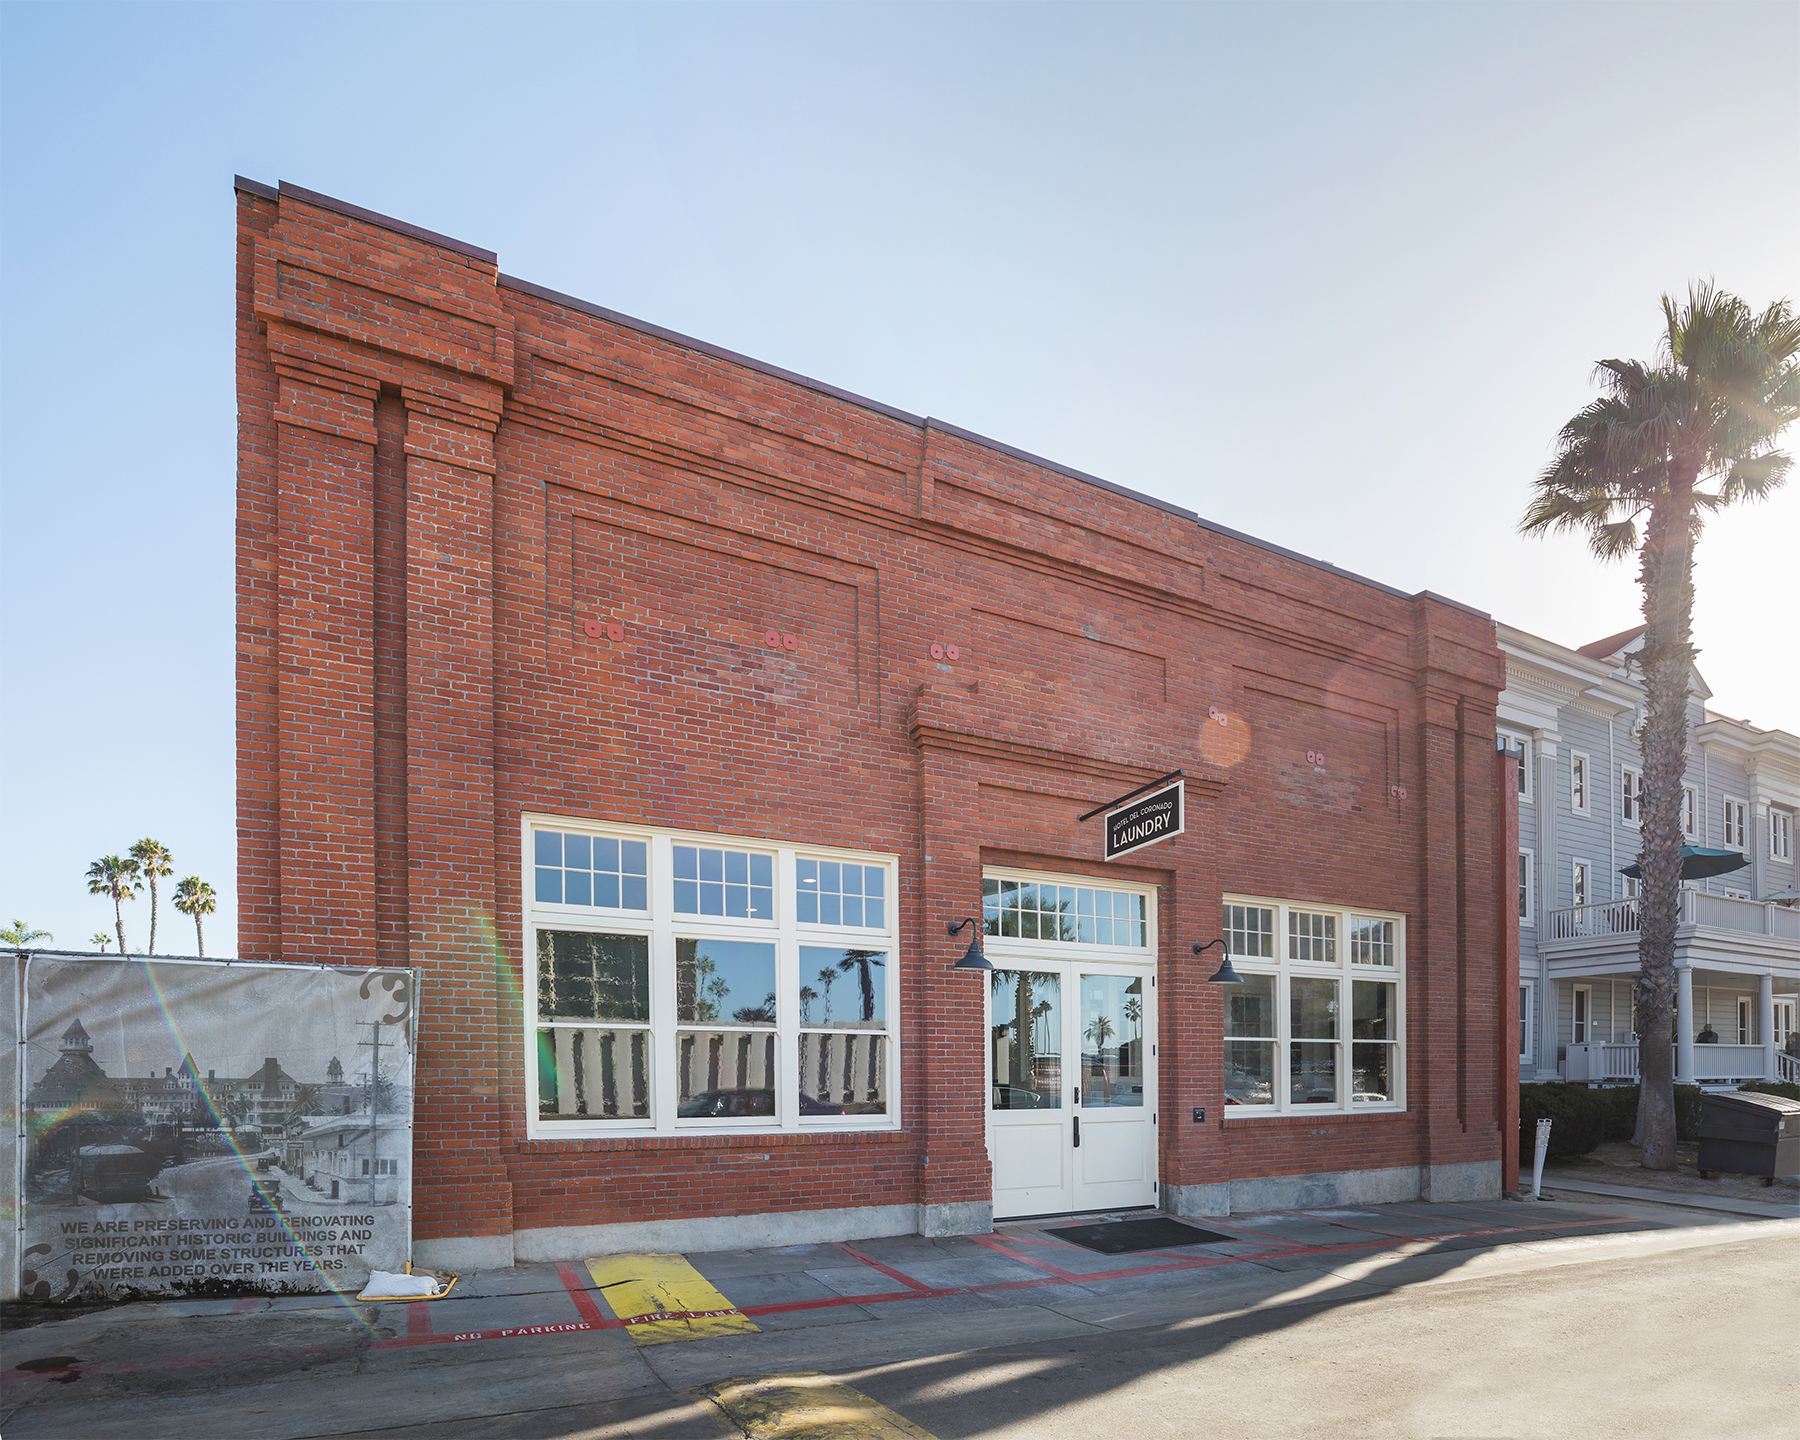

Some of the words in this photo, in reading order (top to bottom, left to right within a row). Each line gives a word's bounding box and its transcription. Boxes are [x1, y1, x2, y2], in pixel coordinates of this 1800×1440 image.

[1113, 817, 1129, 831] HOTEL
[1129, 811, 1140, 821] DEL
[1140, 801, 1173, 816] CORONADO
[1113, 810, 1171, 848] LAUNDRY
[60, 1222, 89, 1234] WE
[92, 1221, 129, 1233] ARE
[133, 1218, 239, 1232] PRESERVING
[242, 1217, 276, 1229] AND
[280, 1215, 375, 1228] RENOVATING
[64, 1235, 172, 1250] SIGNIFICANT
[176, 1233, 252, 1246] HISTORIC
[256, 1230, 337, 1243] BUILDINGS
[340, 1230, 372, 1241] AND
[72, 1251, 164, 1265] REMOVING
[169, 1249, 216, 1261] SOME
[220, 1245, 323, 1260] STRUCTURES
[326, 1244, 366, 1256] THAT
[93, 1267, 145, 1280] WERE
[148, 1264, 206, 1278] ADDED
[210, 1263, 255, 1275] OVER
[258, 1261, 289, 1273] THE
[292, 1259, 347, 1272] YEARS.
[630, 1312, 676, 1324] FIRE
[689, 1308, 741, 1318] LANE
[454, 1332, 482, 1341] NO
[501, 1322, 591, 1337] PARKING
